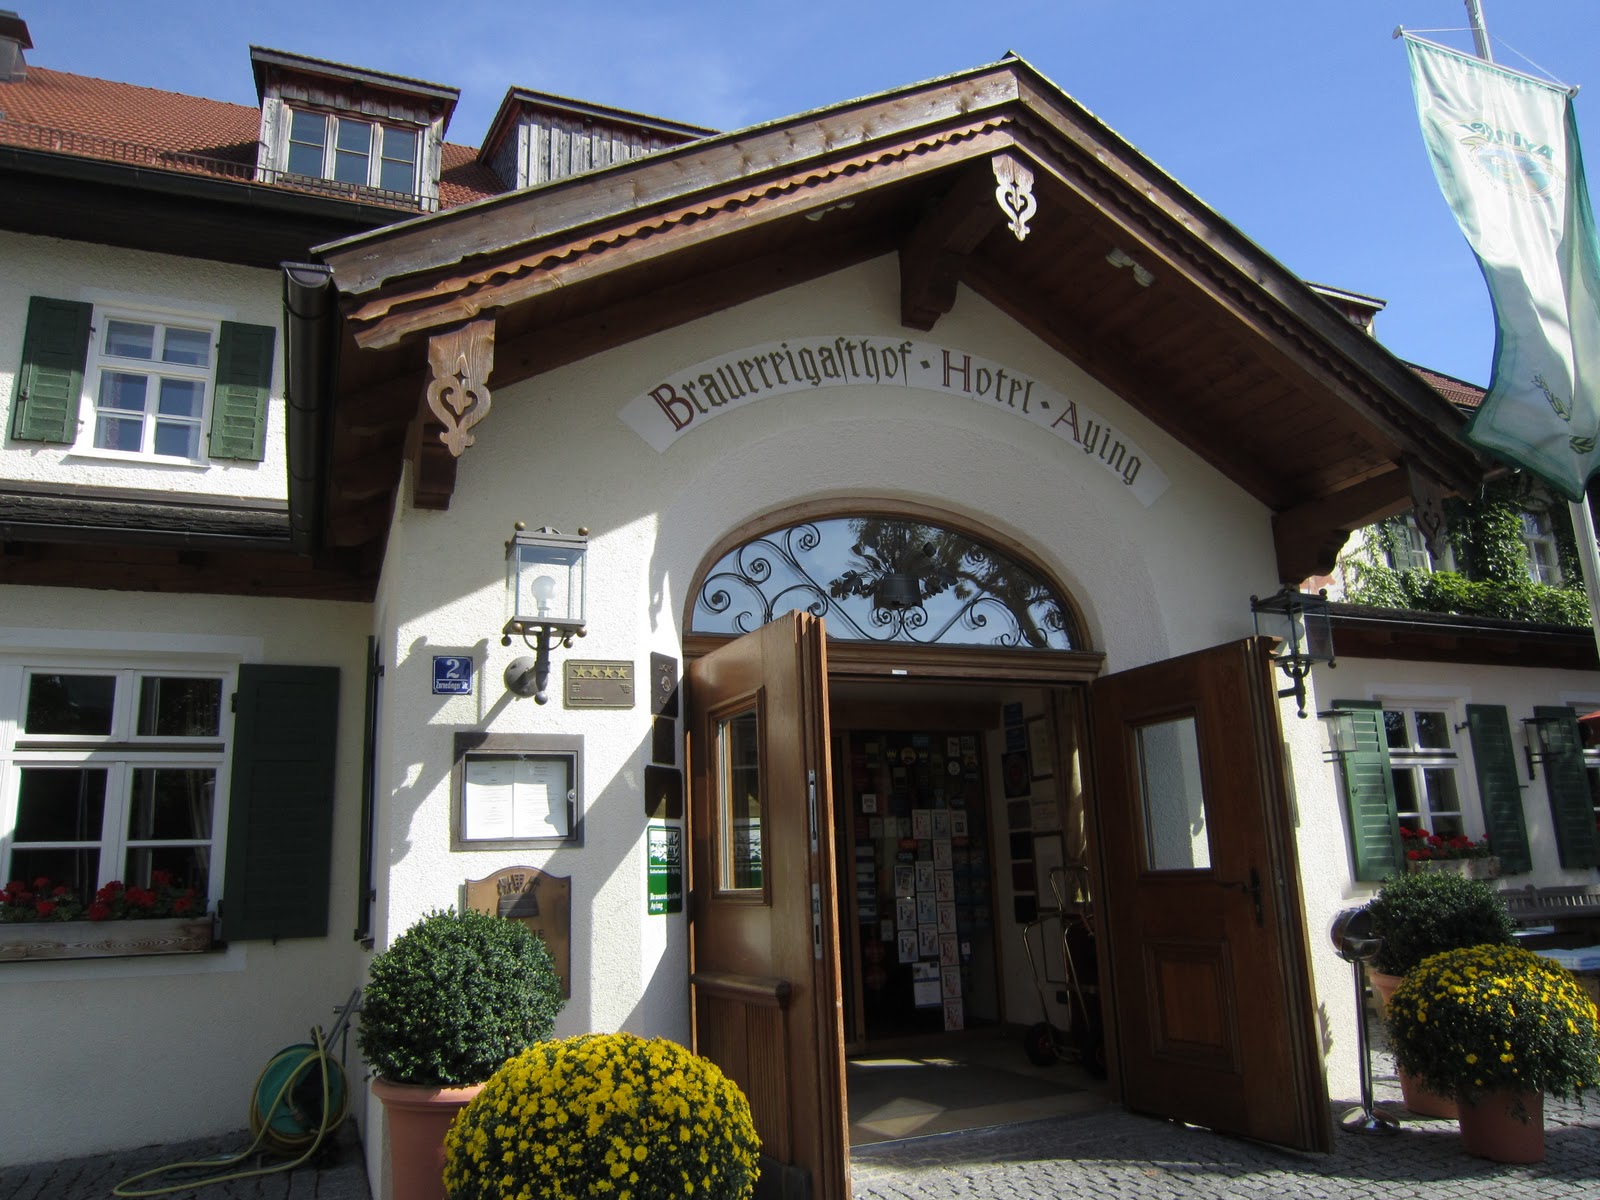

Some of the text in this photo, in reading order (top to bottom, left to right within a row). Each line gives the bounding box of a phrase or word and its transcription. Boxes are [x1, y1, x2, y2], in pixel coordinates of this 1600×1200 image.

[941, 349, 1035, 414] Hotel
[1050, 400, 1142, 486] Aying
[446, 658, 460, 679] 2
